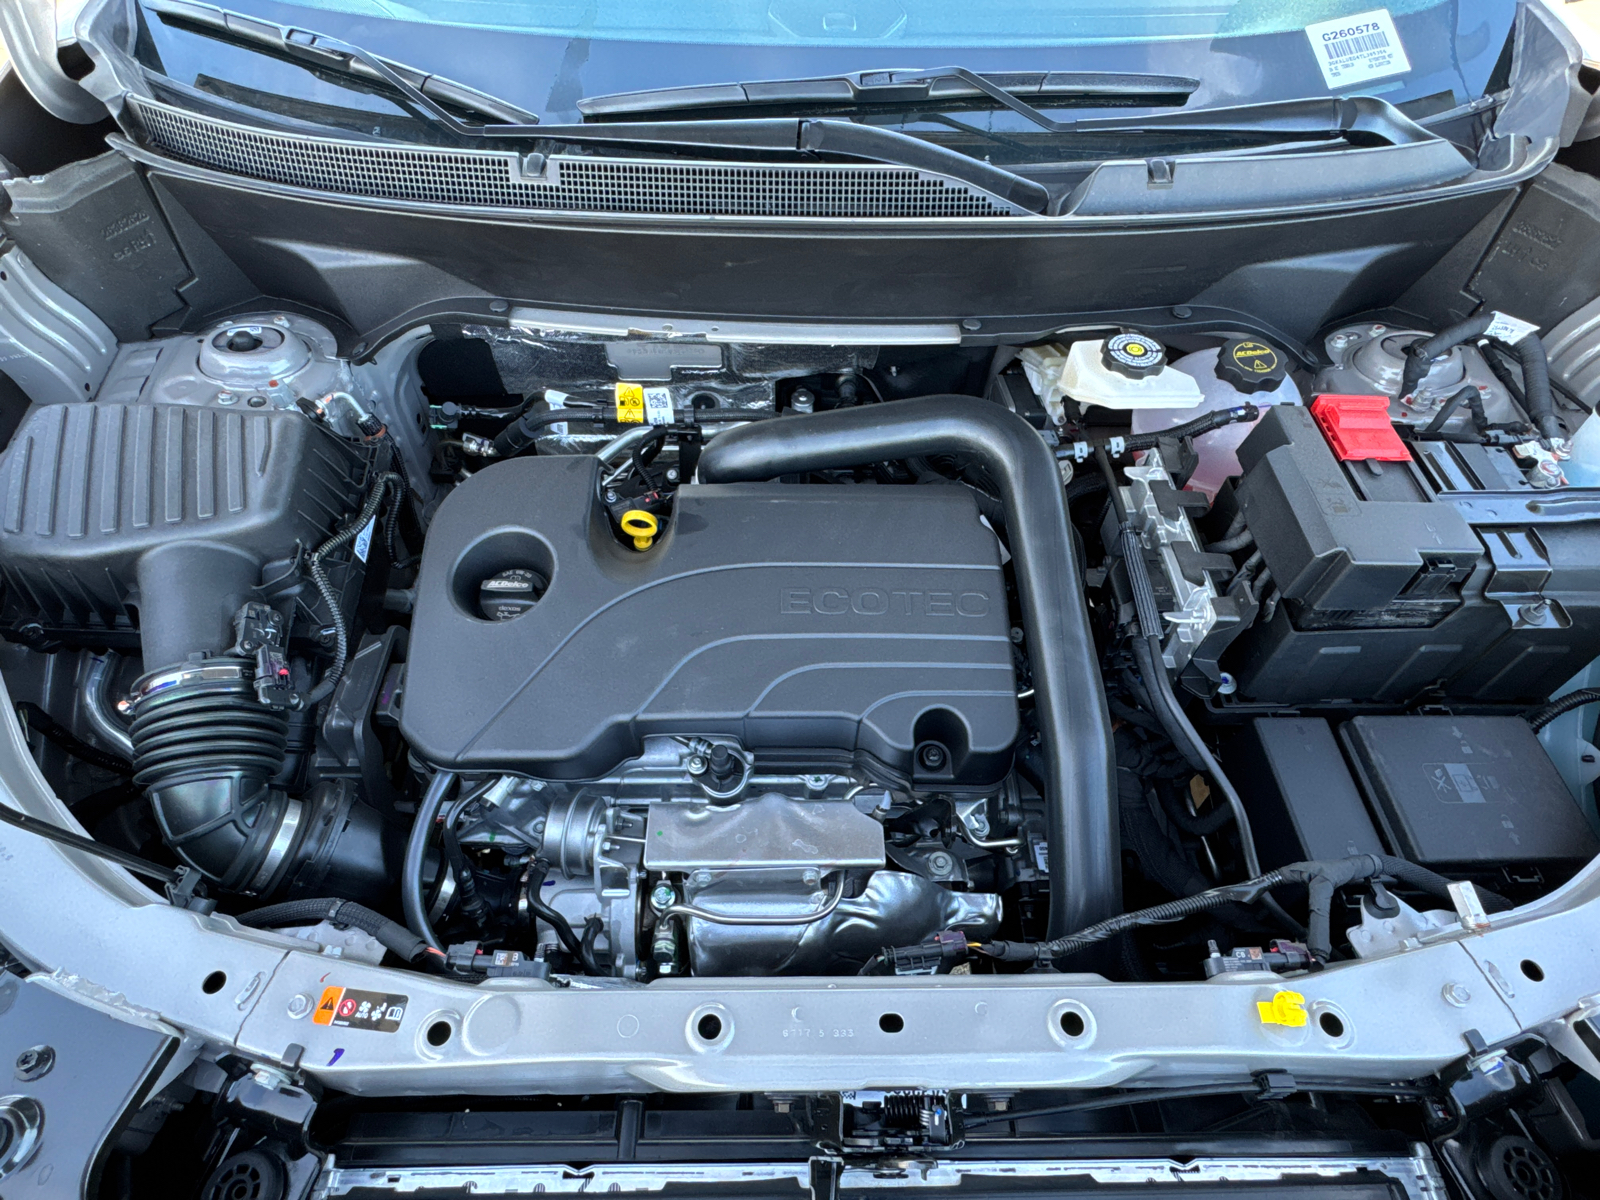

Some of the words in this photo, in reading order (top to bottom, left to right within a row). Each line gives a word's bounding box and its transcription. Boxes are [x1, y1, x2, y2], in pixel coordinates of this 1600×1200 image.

[1322, 22, 1380, 41] G260578
[486, 580, 528, 588] ACDelco
[780, 587, 990, 618] ECOTEC
